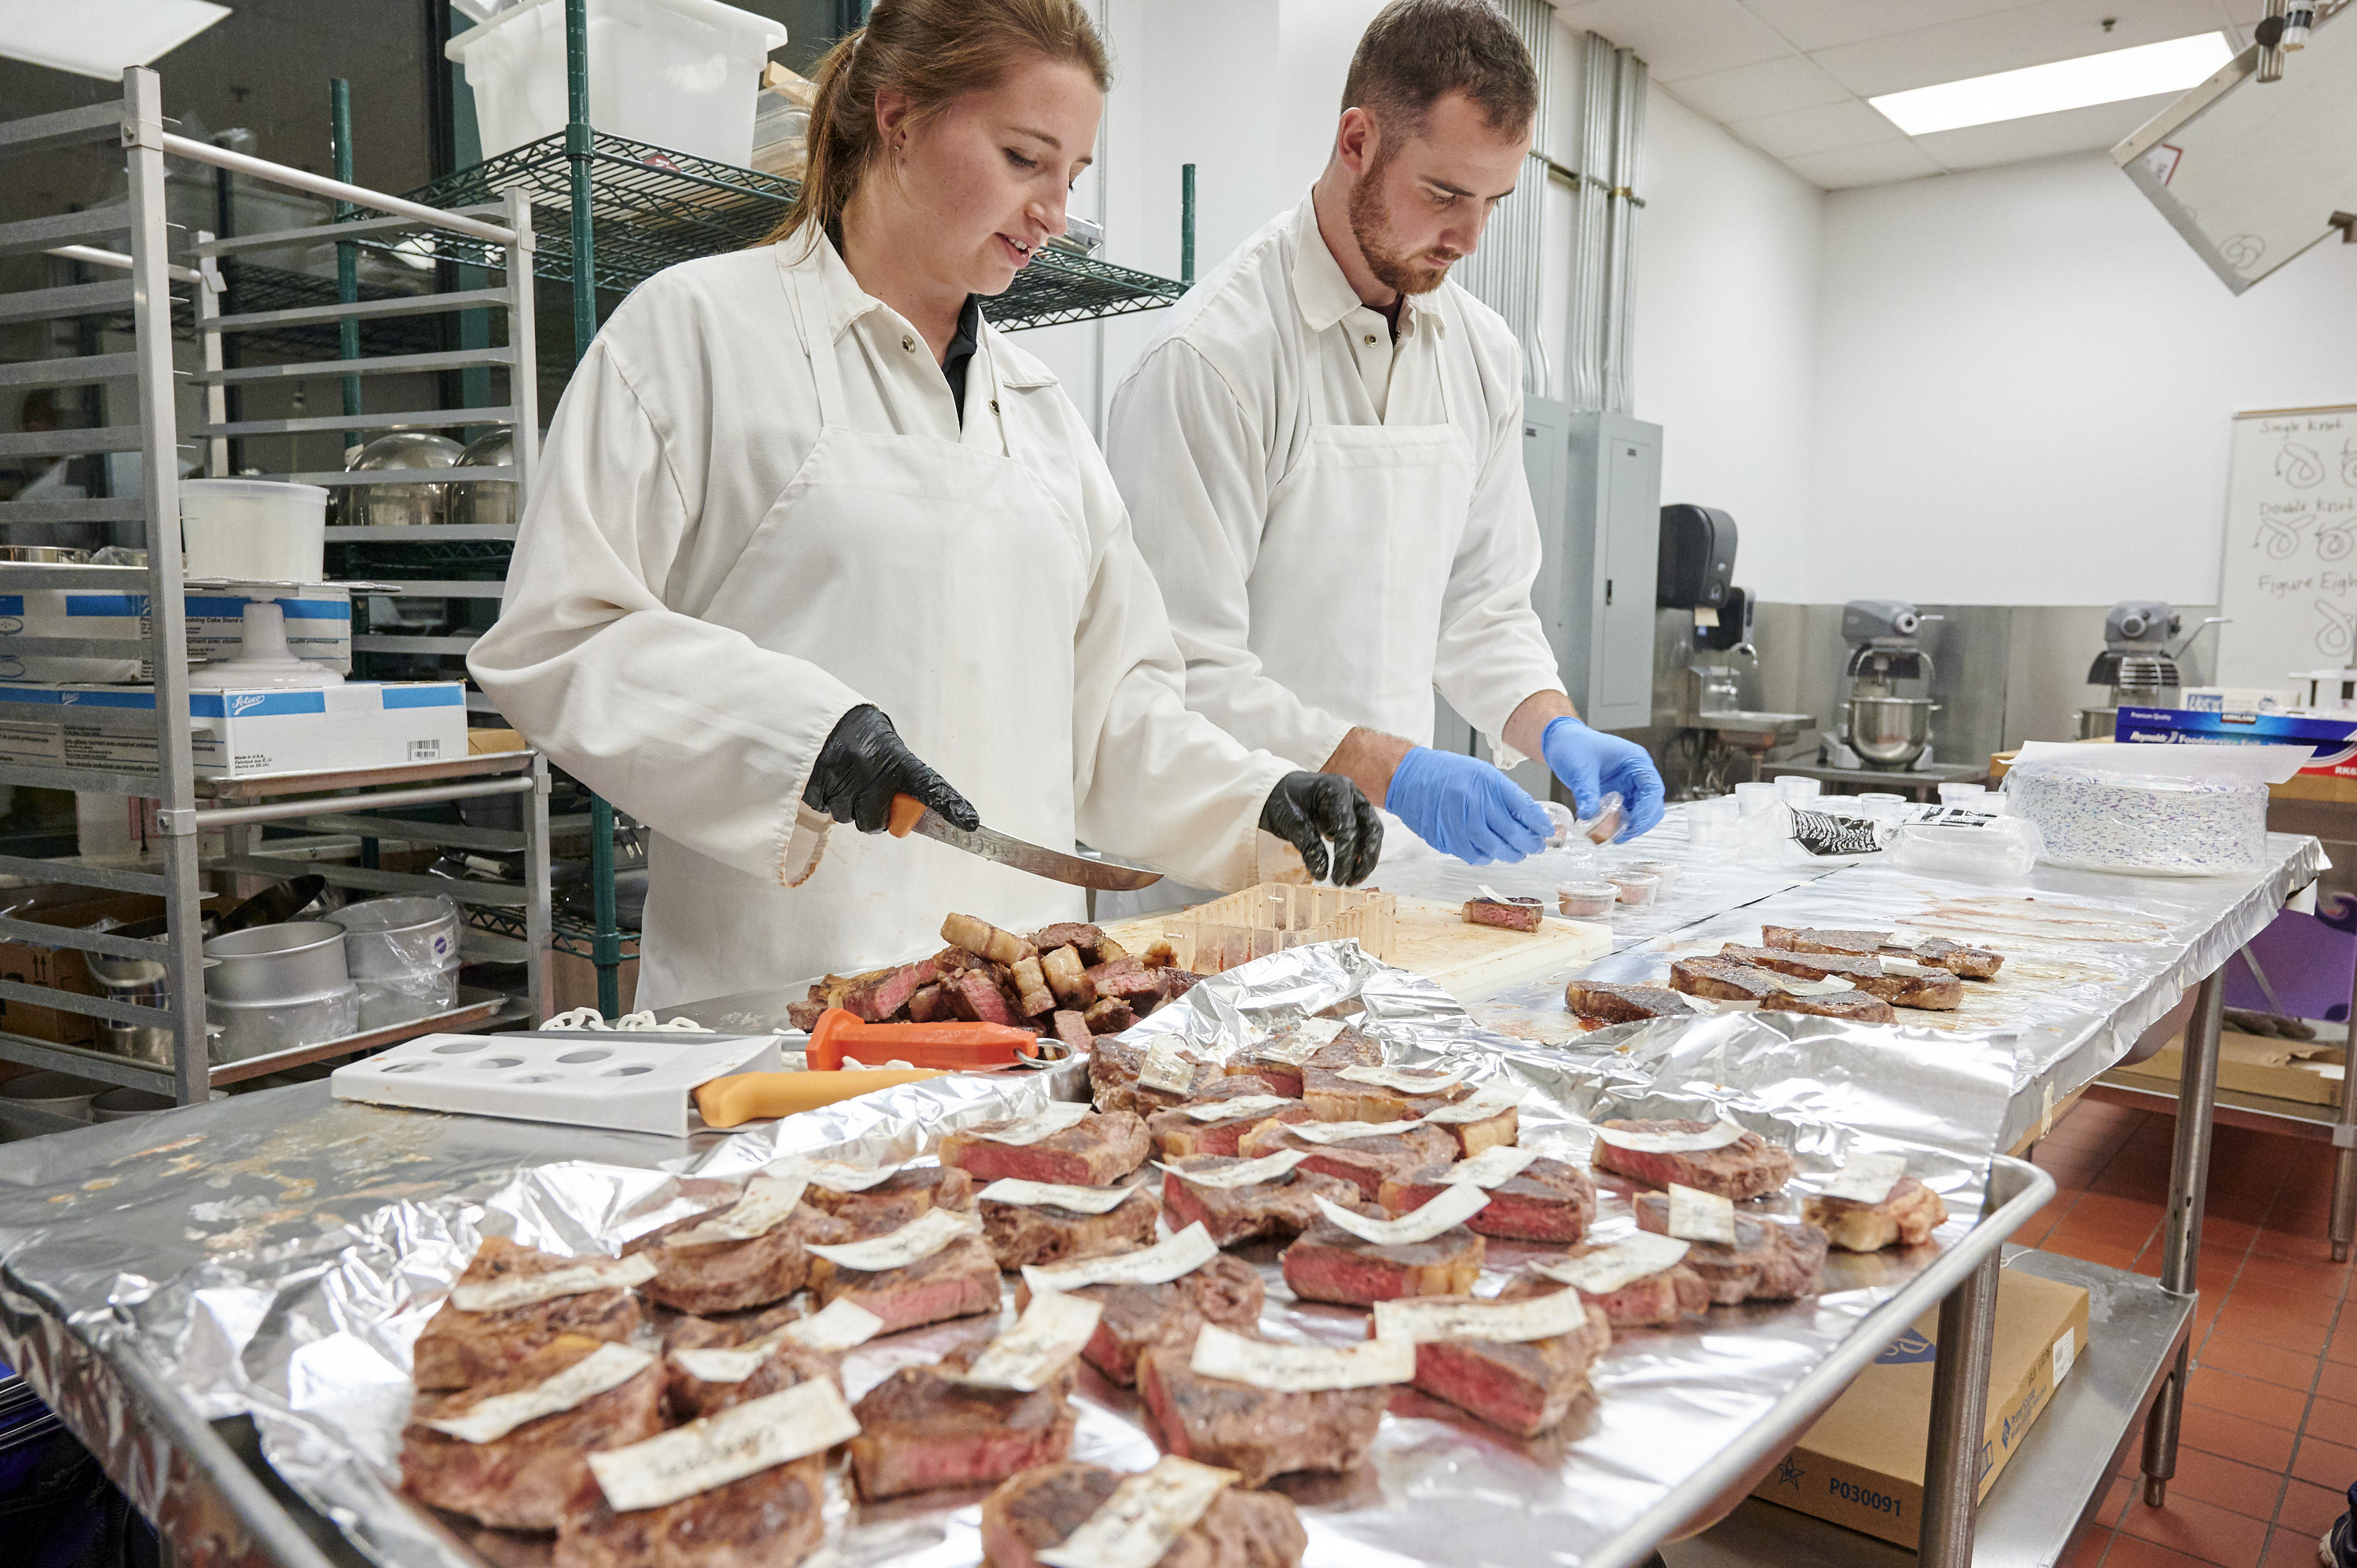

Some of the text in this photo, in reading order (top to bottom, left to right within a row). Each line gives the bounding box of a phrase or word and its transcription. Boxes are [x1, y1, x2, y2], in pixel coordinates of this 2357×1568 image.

[2258, 573, 2312, 599] Figure
[2130, 711, 2172, 721] Premium Quality
[2130, 731, 2169, 743] Reynolds
[2179, 734, 2239, 746] Foodservice
[1829, 1477, 1902, 1518] P030091
